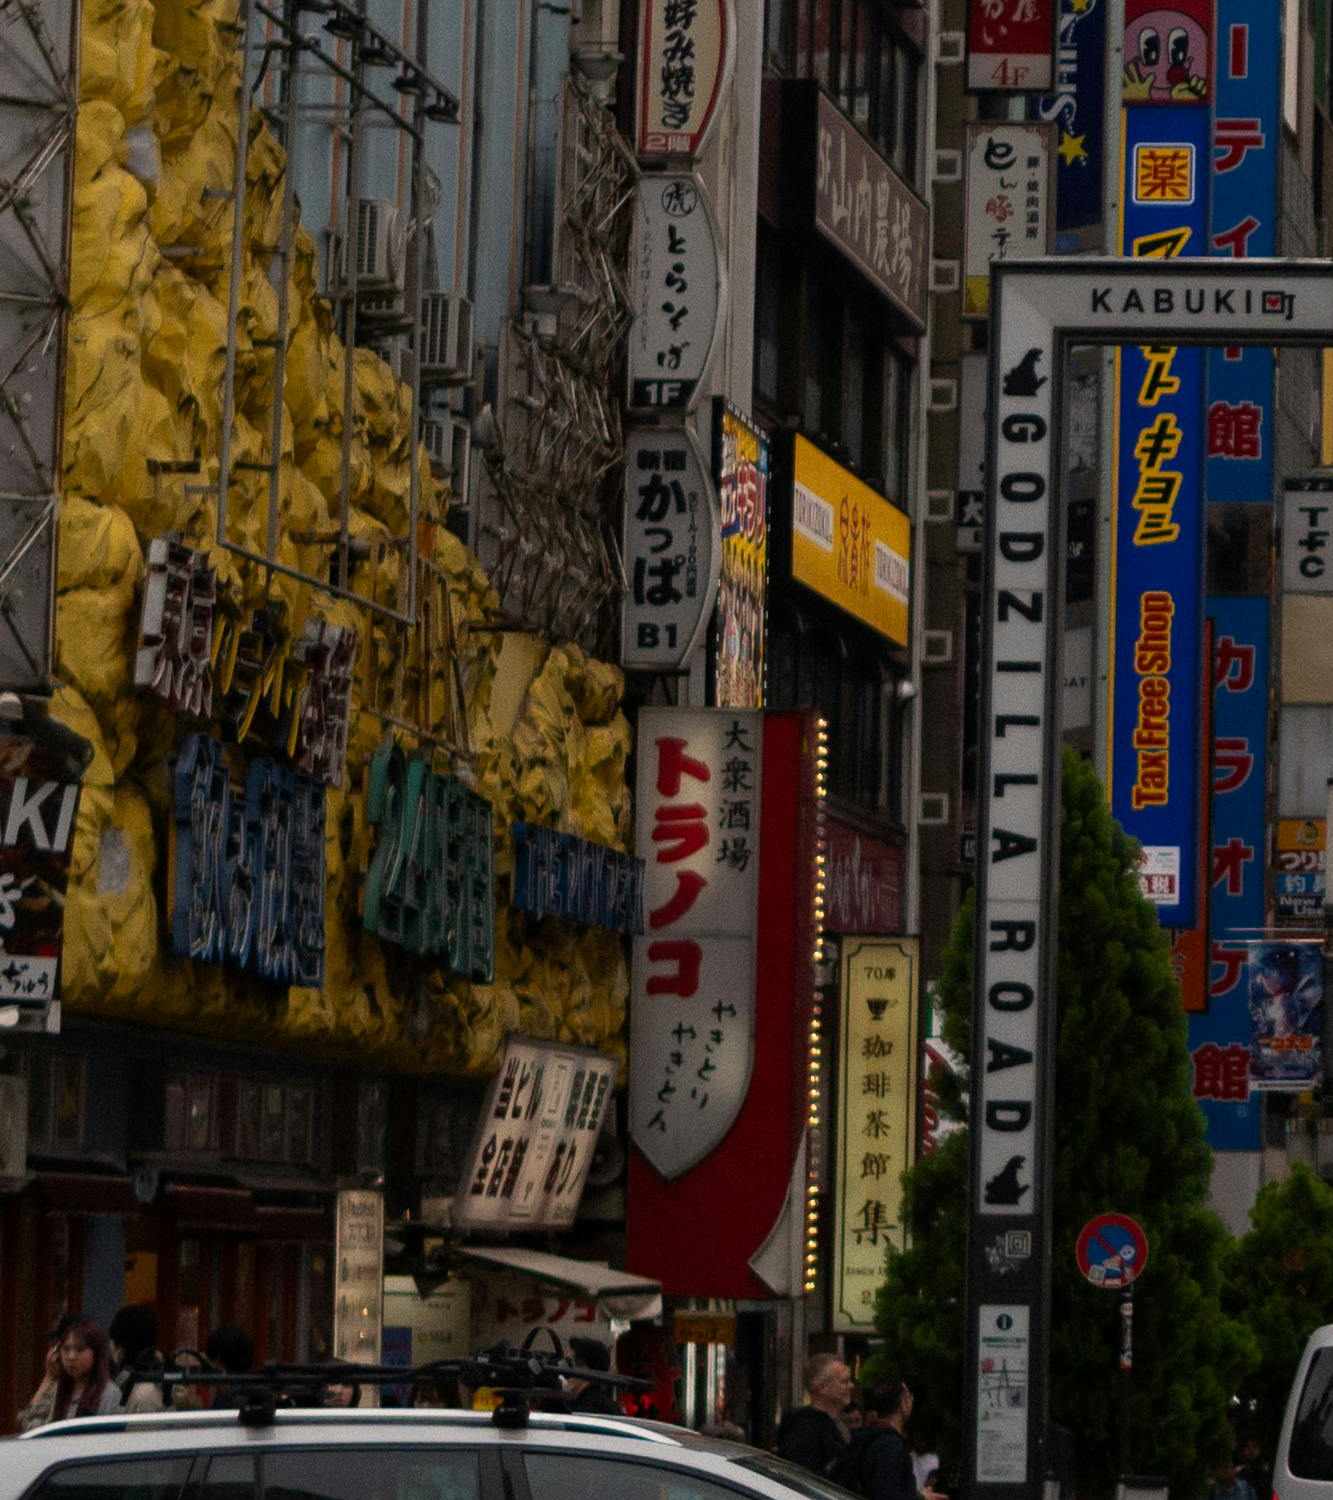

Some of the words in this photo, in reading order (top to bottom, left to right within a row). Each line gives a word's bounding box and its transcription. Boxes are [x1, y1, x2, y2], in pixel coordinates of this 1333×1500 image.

[991, 58, 1029, 88] 4F
[1140, 149, 1190, 198] 薬
[658, 223, 690, 370] とらそば
[1090, 286, 1298, 322] KABUKI町
[644, 381, 682, 405] 1F
[633, 474, 689, 608] かっぱ
[636, 622, 679, 650] B1
[991, 412, 1048, 864] GODZILLA
[1134, 591, 1176, 675] Shop
[1132, 676, 1171, 749] Free
[715, 719, 753, 873] 大衆酒場
[1131, 749, 1169, 811] Tax
[646, 734, 712, 999] トラノコ
[984, 918, 1037, 1134] ROAD
